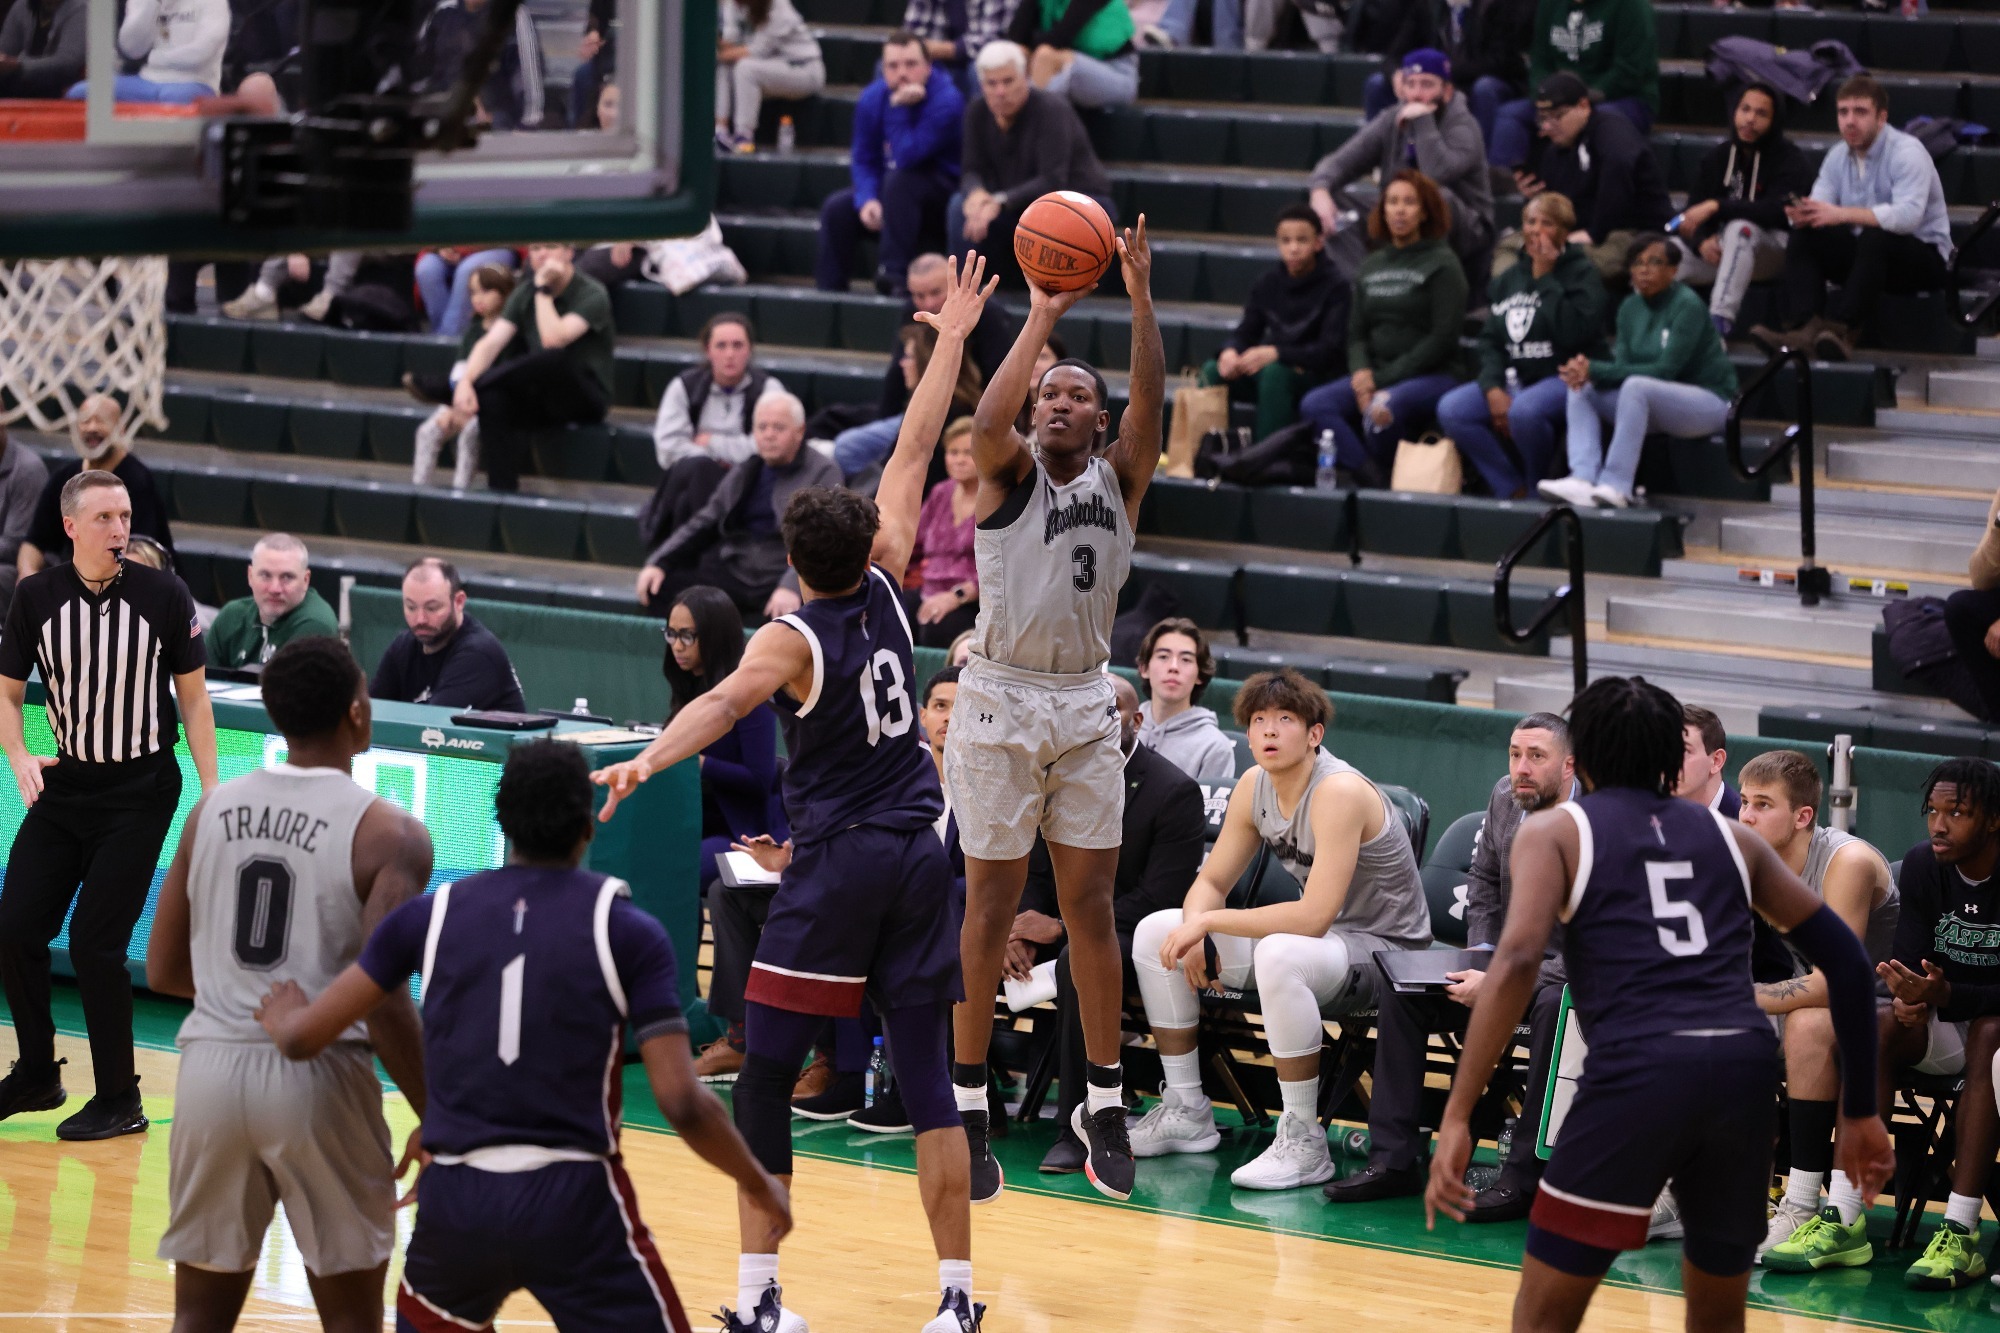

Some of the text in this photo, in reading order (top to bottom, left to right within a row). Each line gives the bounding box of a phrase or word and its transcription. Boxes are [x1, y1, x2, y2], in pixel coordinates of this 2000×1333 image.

[1072, 544, 1097, 593] 3
[446, 737, 485, 750] ANC
[859, 648, 914, 747] 13
[219, 805, 329, 854] TRAORE
[231, 853, 297, 973] 0
[1644, 860, 1709, 957] 5
[498, 953, 526, 1067] 1
